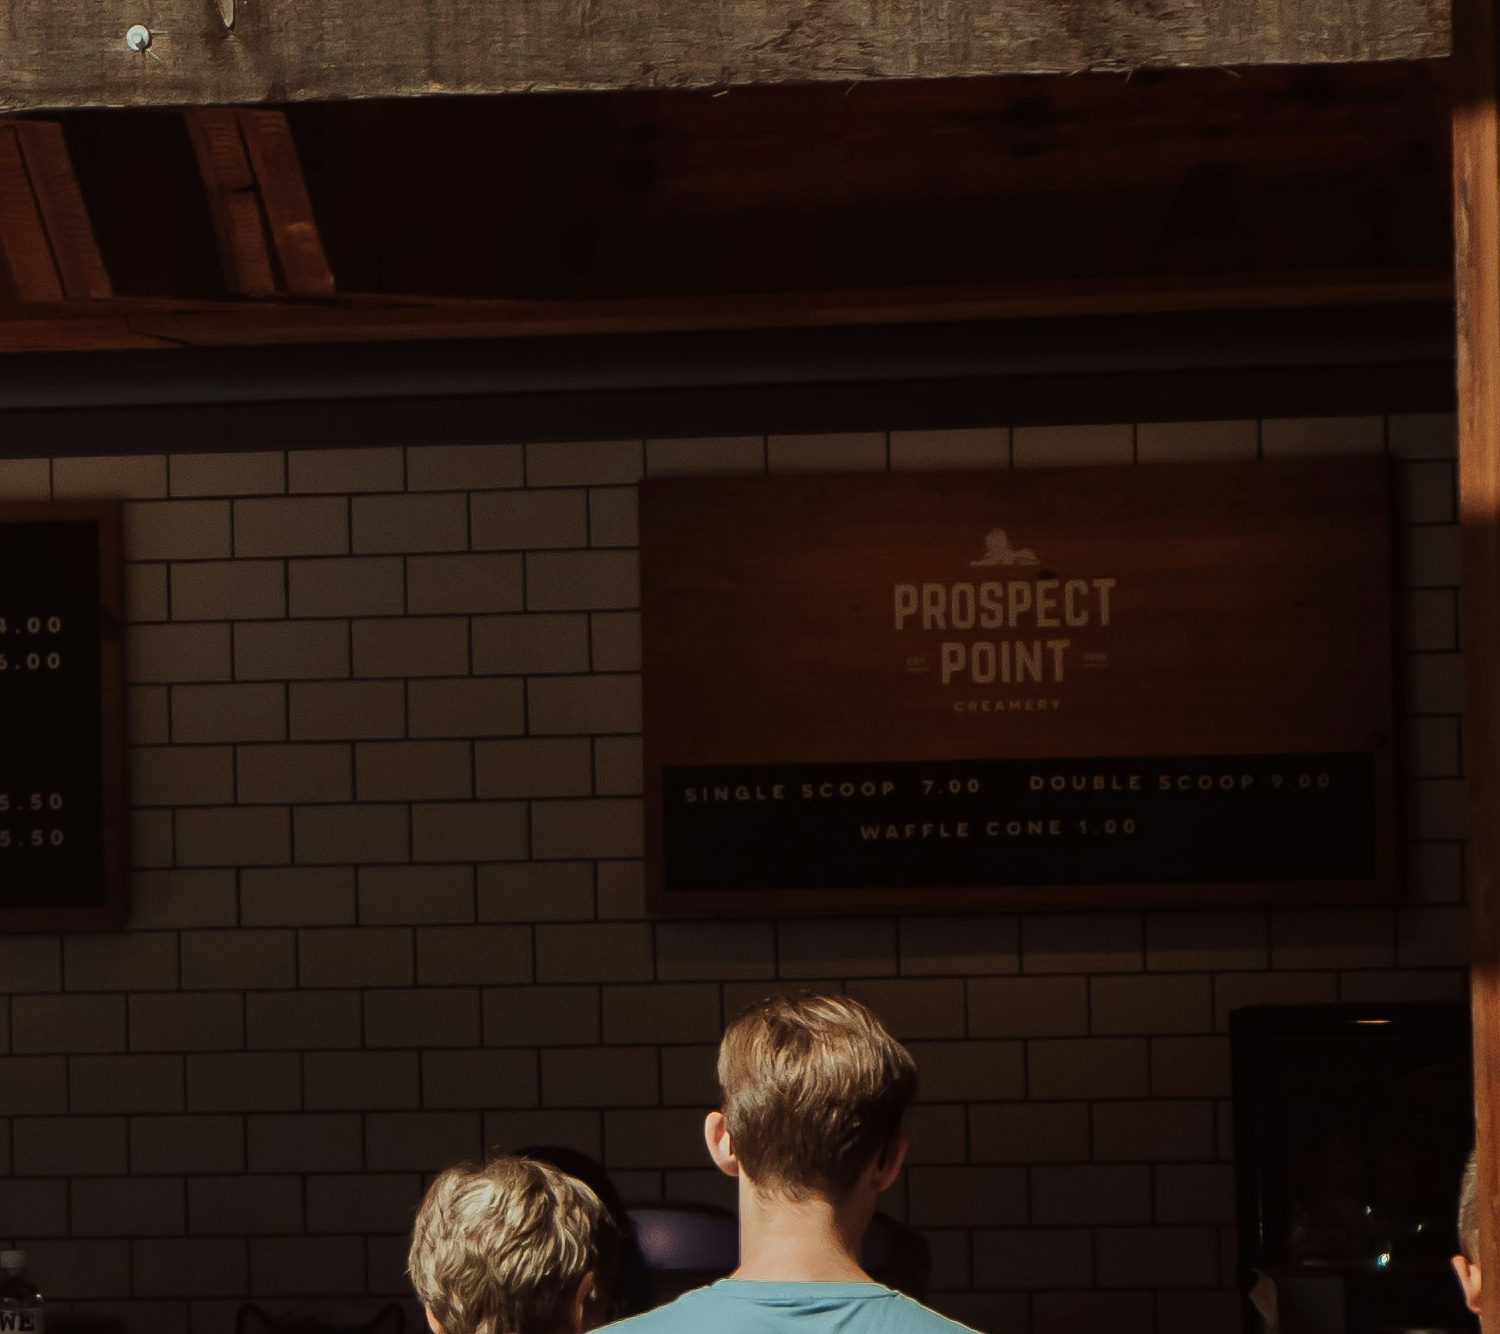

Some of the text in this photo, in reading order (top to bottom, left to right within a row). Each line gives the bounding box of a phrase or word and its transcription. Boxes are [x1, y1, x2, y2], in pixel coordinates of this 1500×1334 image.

[893, 578, 1116, 631] PROSPECT
[940, 639, 1071, 685] POINT
[953, 698, 1060, 713] CREAMERY
[685, 778, 980, 803] SINGLE SCOOP 7.00
[1029, 772, 1330, 791] DOUBLE SCOOP 9.00
[860, 818, 1136, 840] WAFFLE CONE 1.00
